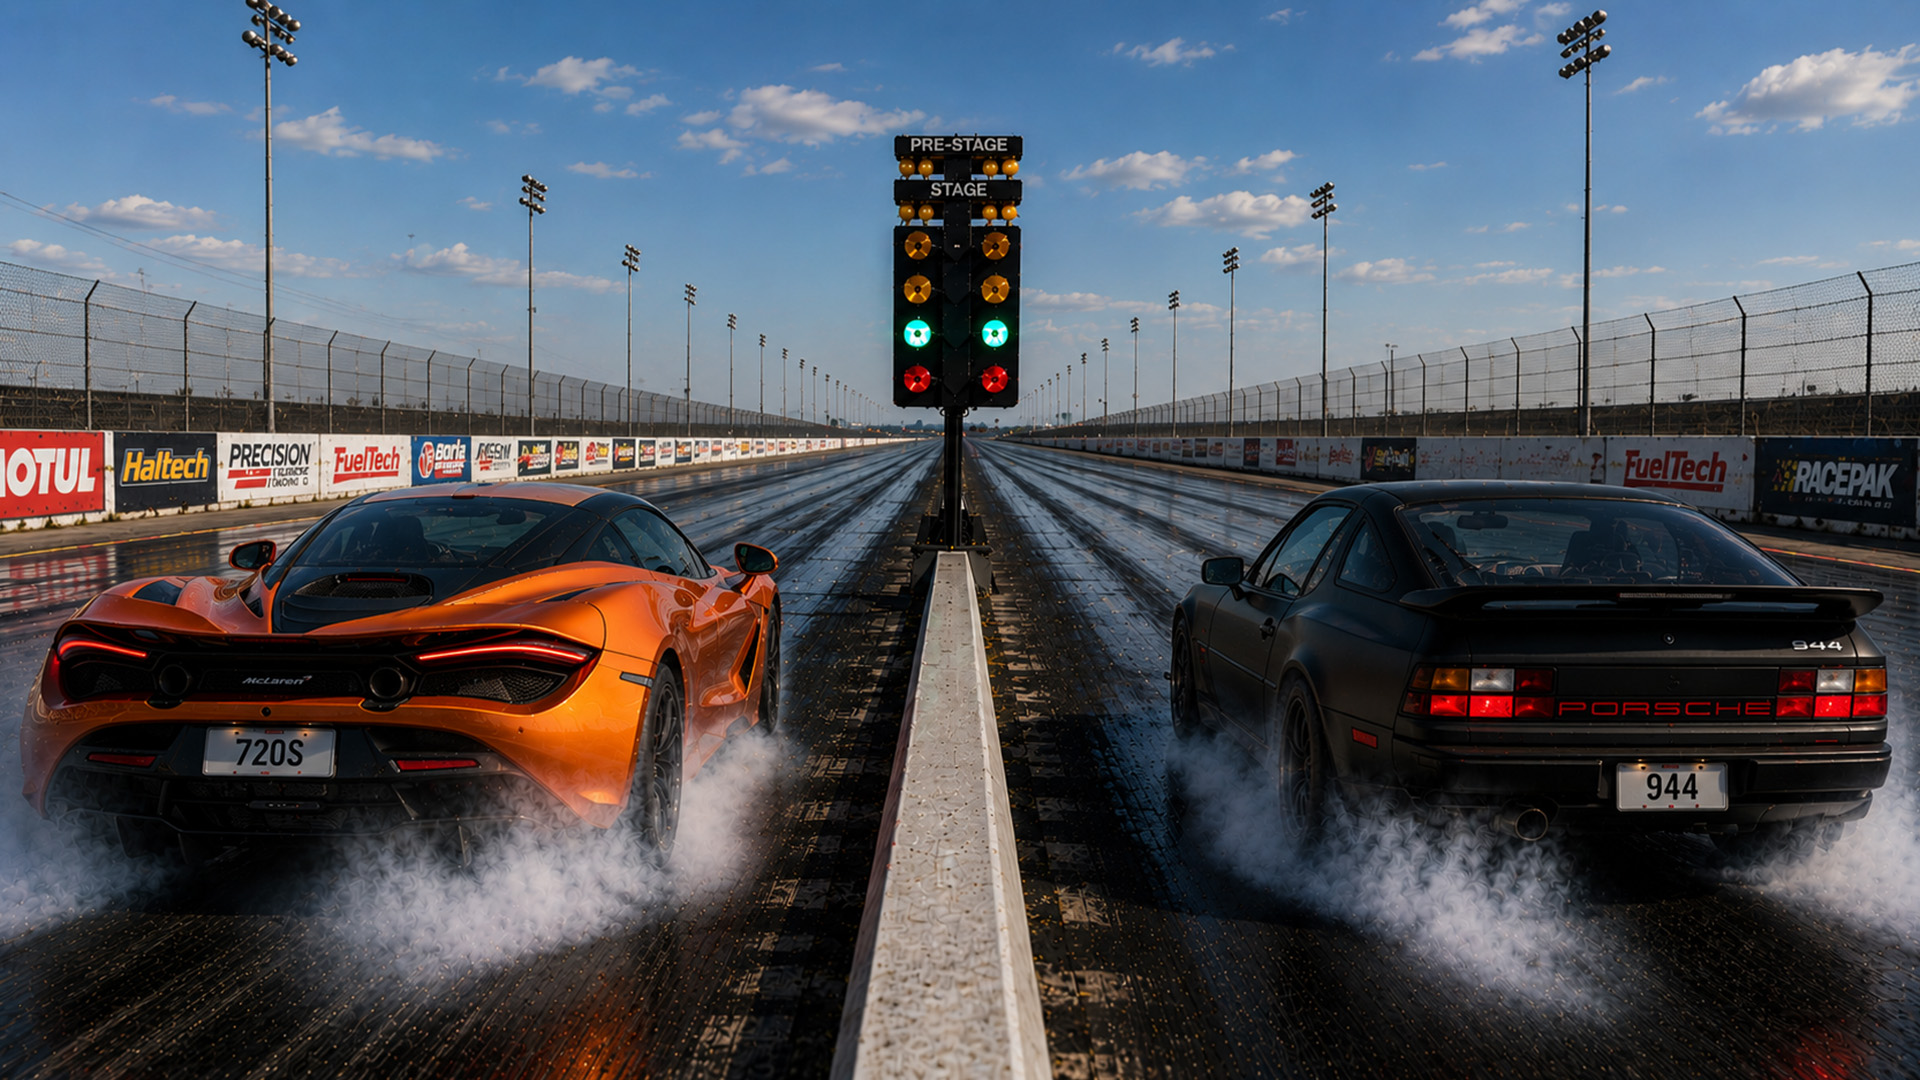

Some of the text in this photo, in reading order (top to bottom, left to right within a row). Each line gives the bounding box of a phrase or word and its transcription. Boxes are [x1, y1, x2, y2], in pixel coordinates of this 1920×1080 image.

[911, 138, 1008, 152] PRE-STAGE
[931, 183, 987, 197] STAGE
[122, 450, 209, 482] Haltech
[229, 443, 311, 468] PRECISION
[334, 445, 400, 472] FuelTech
[1625, 450, 1728, 482] FuelTech
[0, 447, 95, 497] OTUL
[1793, 460, 1899, 499] RACEPAK
[1791, 640, 1843, 651] 944
[242, 677, 304, 685] McLaren
[1558, 702, 1771, 716] PORSCHE
[236, 738, 304, 767] 720S
[1646, 773, 1698, 800] 944
